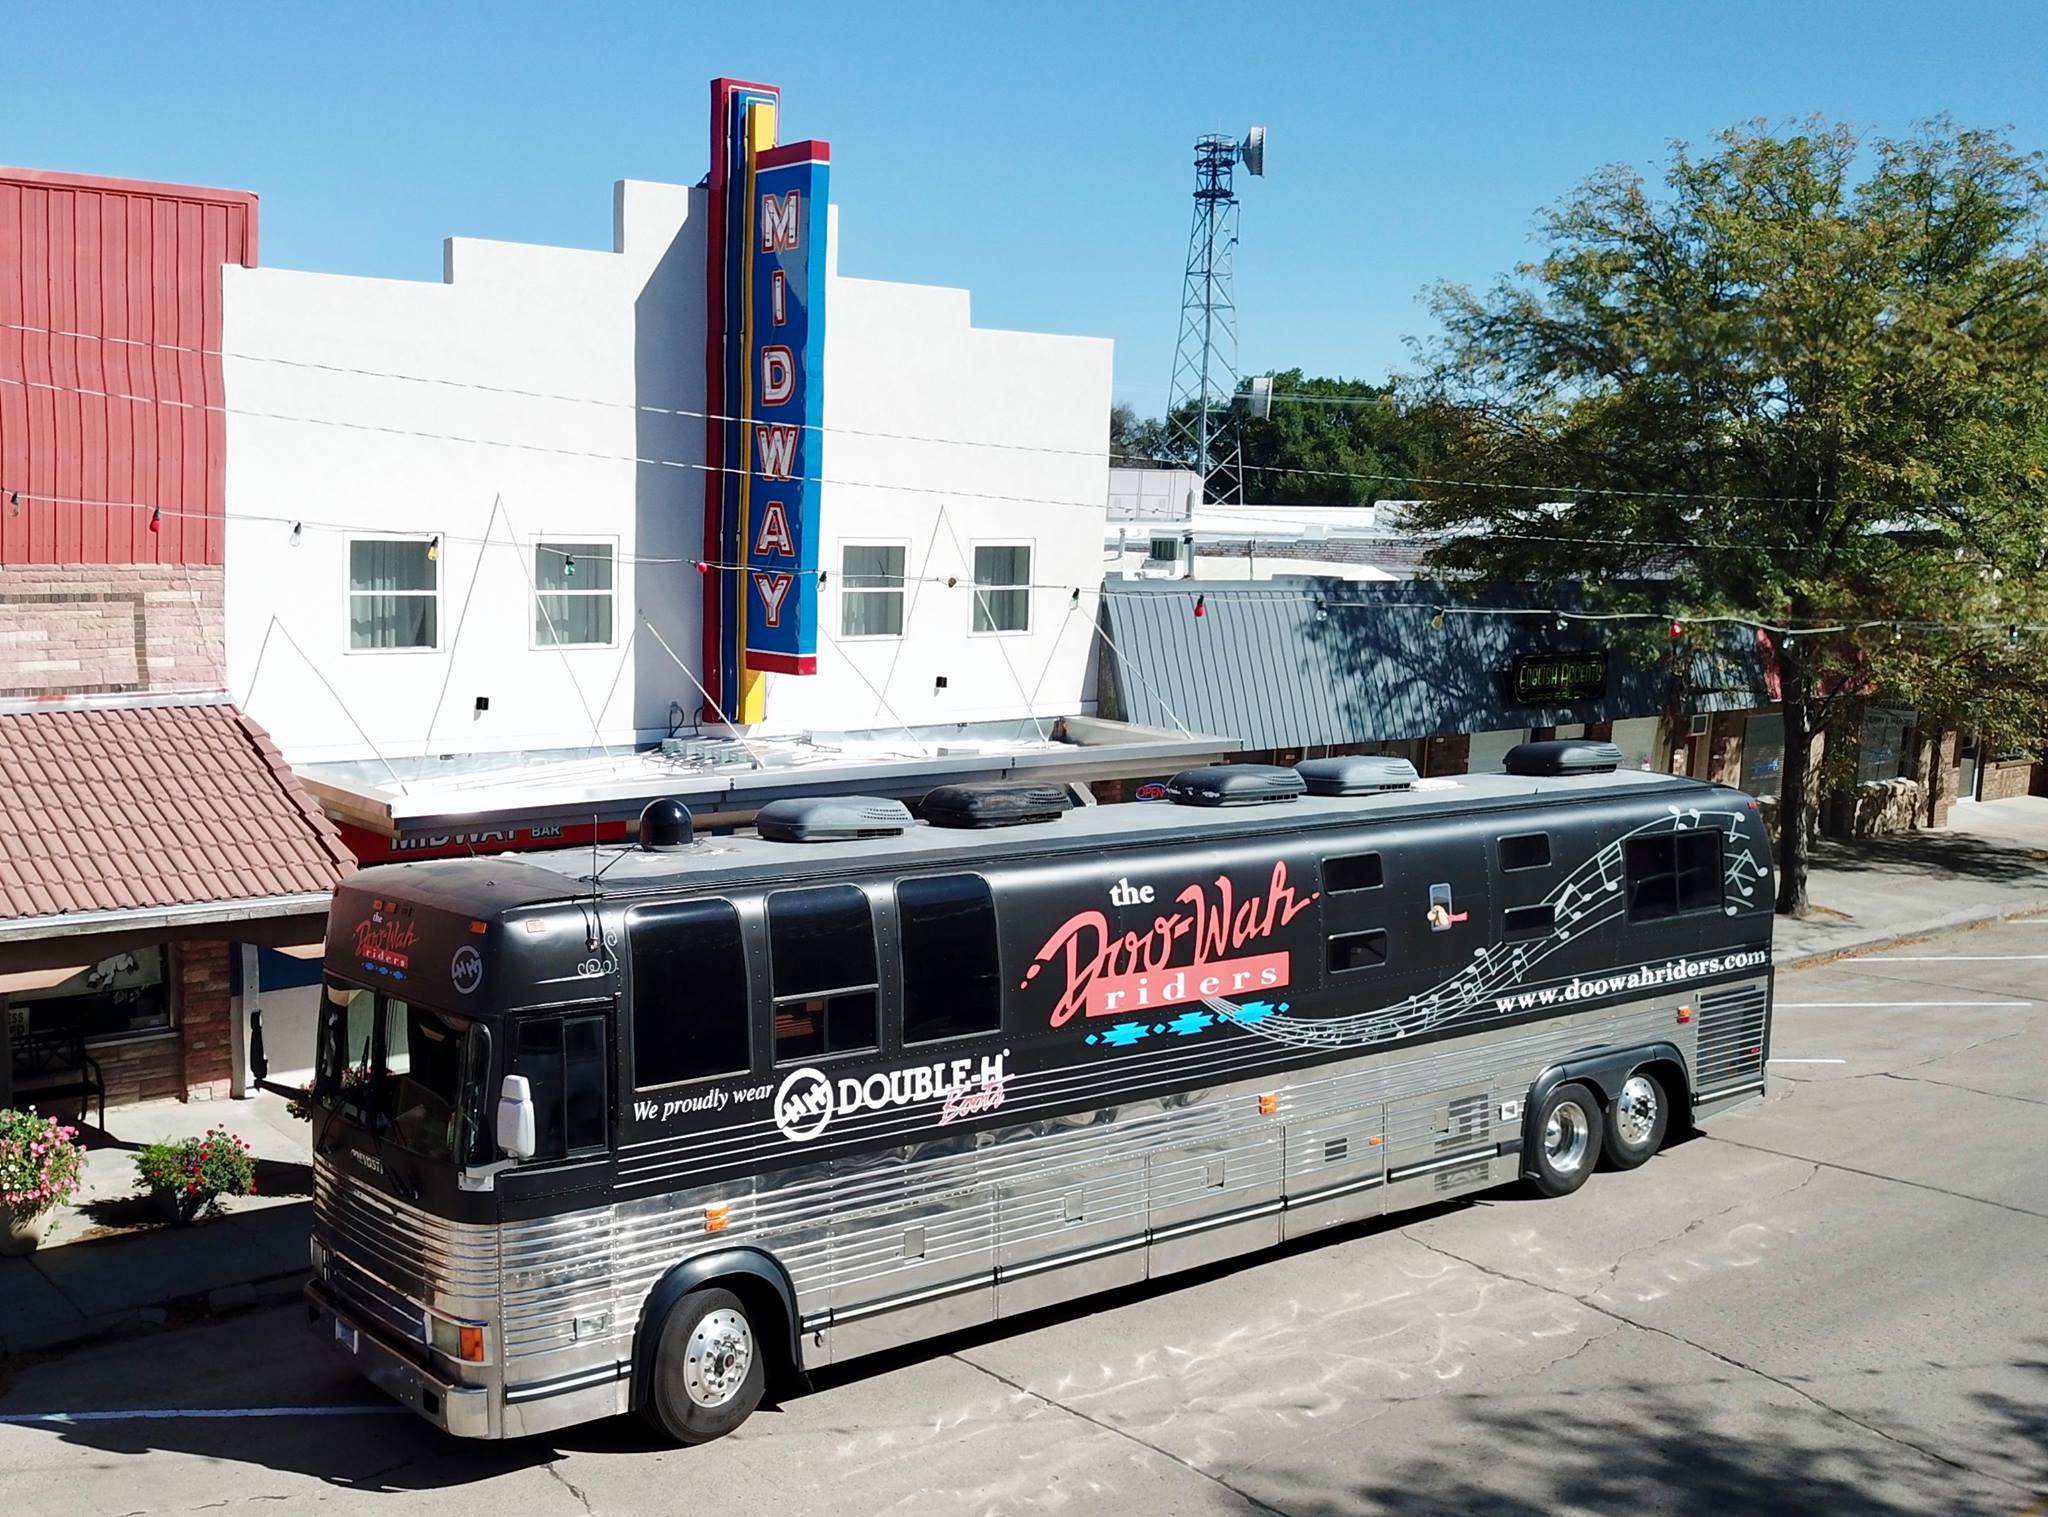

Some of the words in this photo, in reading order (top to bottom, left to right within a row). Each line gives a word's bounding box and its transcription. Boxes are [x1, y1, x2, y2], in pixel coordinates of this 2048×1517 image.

[753, 188, 801, 628] MIDWAY
[1136, 786, 1166, 799] OPEN
[530, 825, 561, 839] BAR
[1109, 877, 1155, 907] the
[372, 911, 383, 923] the
[365, 948, 406, 968] riders
[1033, 860, 1314, 1028] Doo-Wah
[1105, 966, 1277, 1011] riders
[1496, 949, 1766, 1013] www.doowahriders.com
[633, 1101, 658, 1122] We
[661, 1087, 729, 1122] proudly
[732, 1084, 774, 1103] wear
